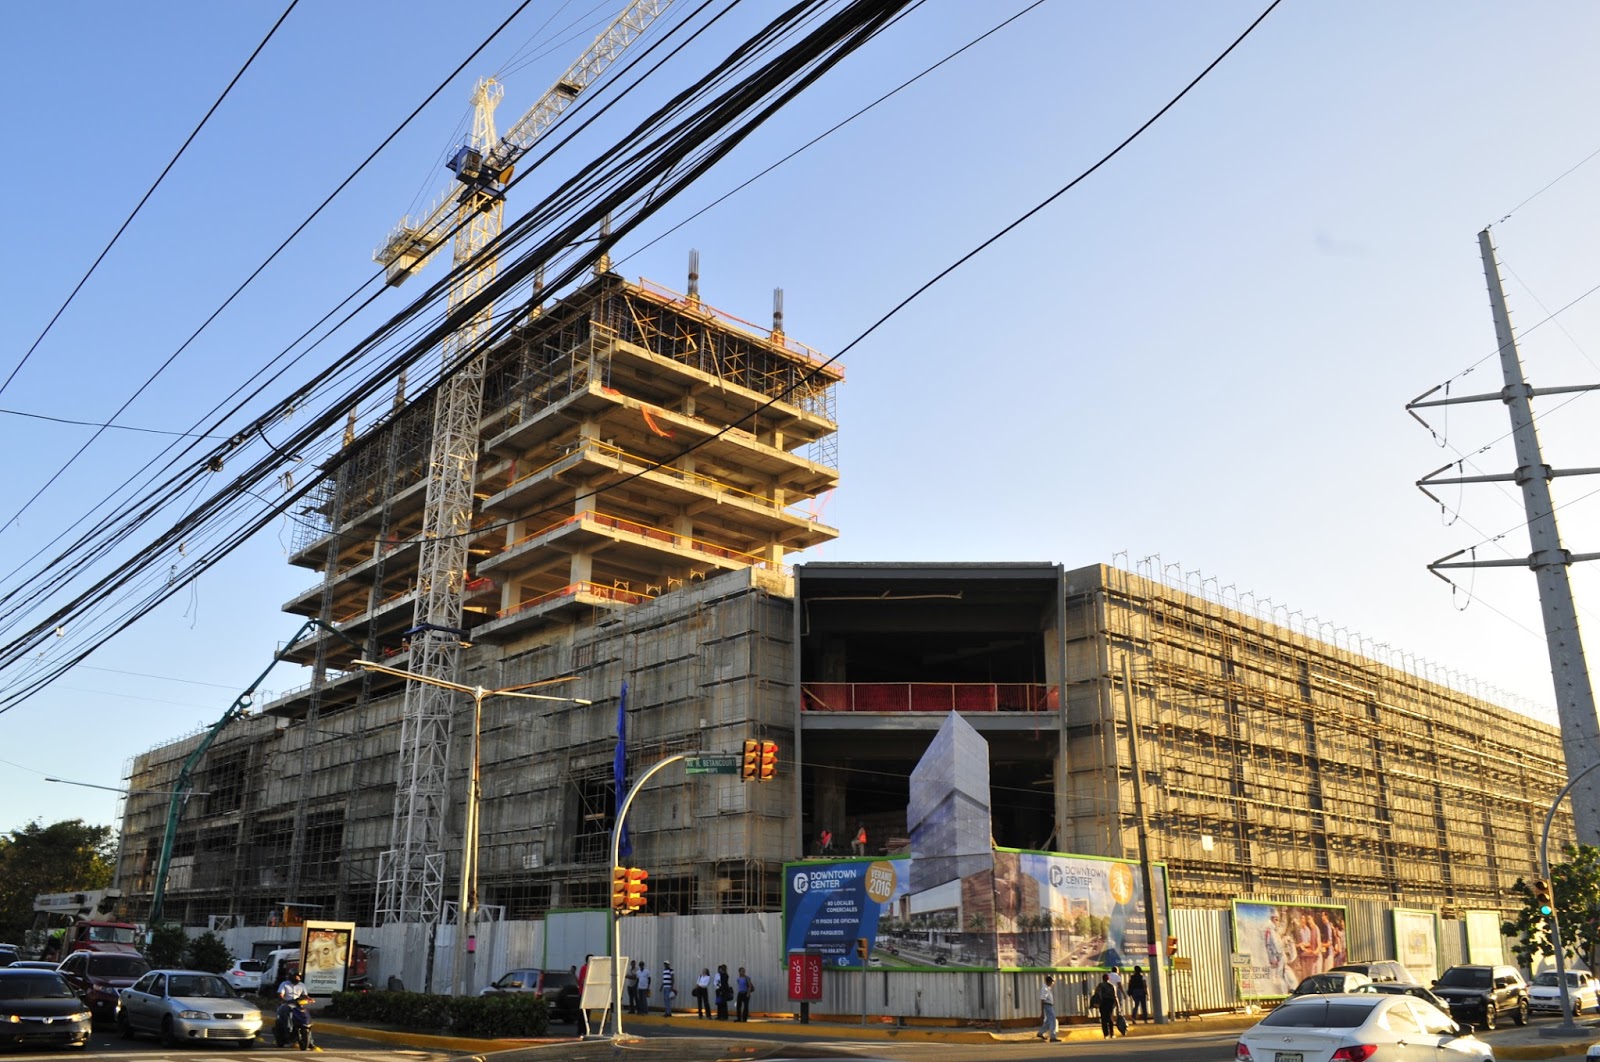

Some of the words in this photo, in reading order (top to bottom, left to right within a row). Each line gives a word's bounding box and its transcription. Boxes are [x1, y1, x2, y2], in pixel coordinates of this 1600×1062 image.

[703, 759, 735, 767] BETANCOURT
[810, 869, 857, 880] DOWNTOWN
[871, 869, 893, 881] VERANO
[1065, 866, 1107, 877] DOWNTOWN
[810, 880, 840, 889] CENTER
[1065, 876, 1093, 886] CENTER
[868, 879, 891, 897] 2016
[811, 963, 819, 994] Claro
